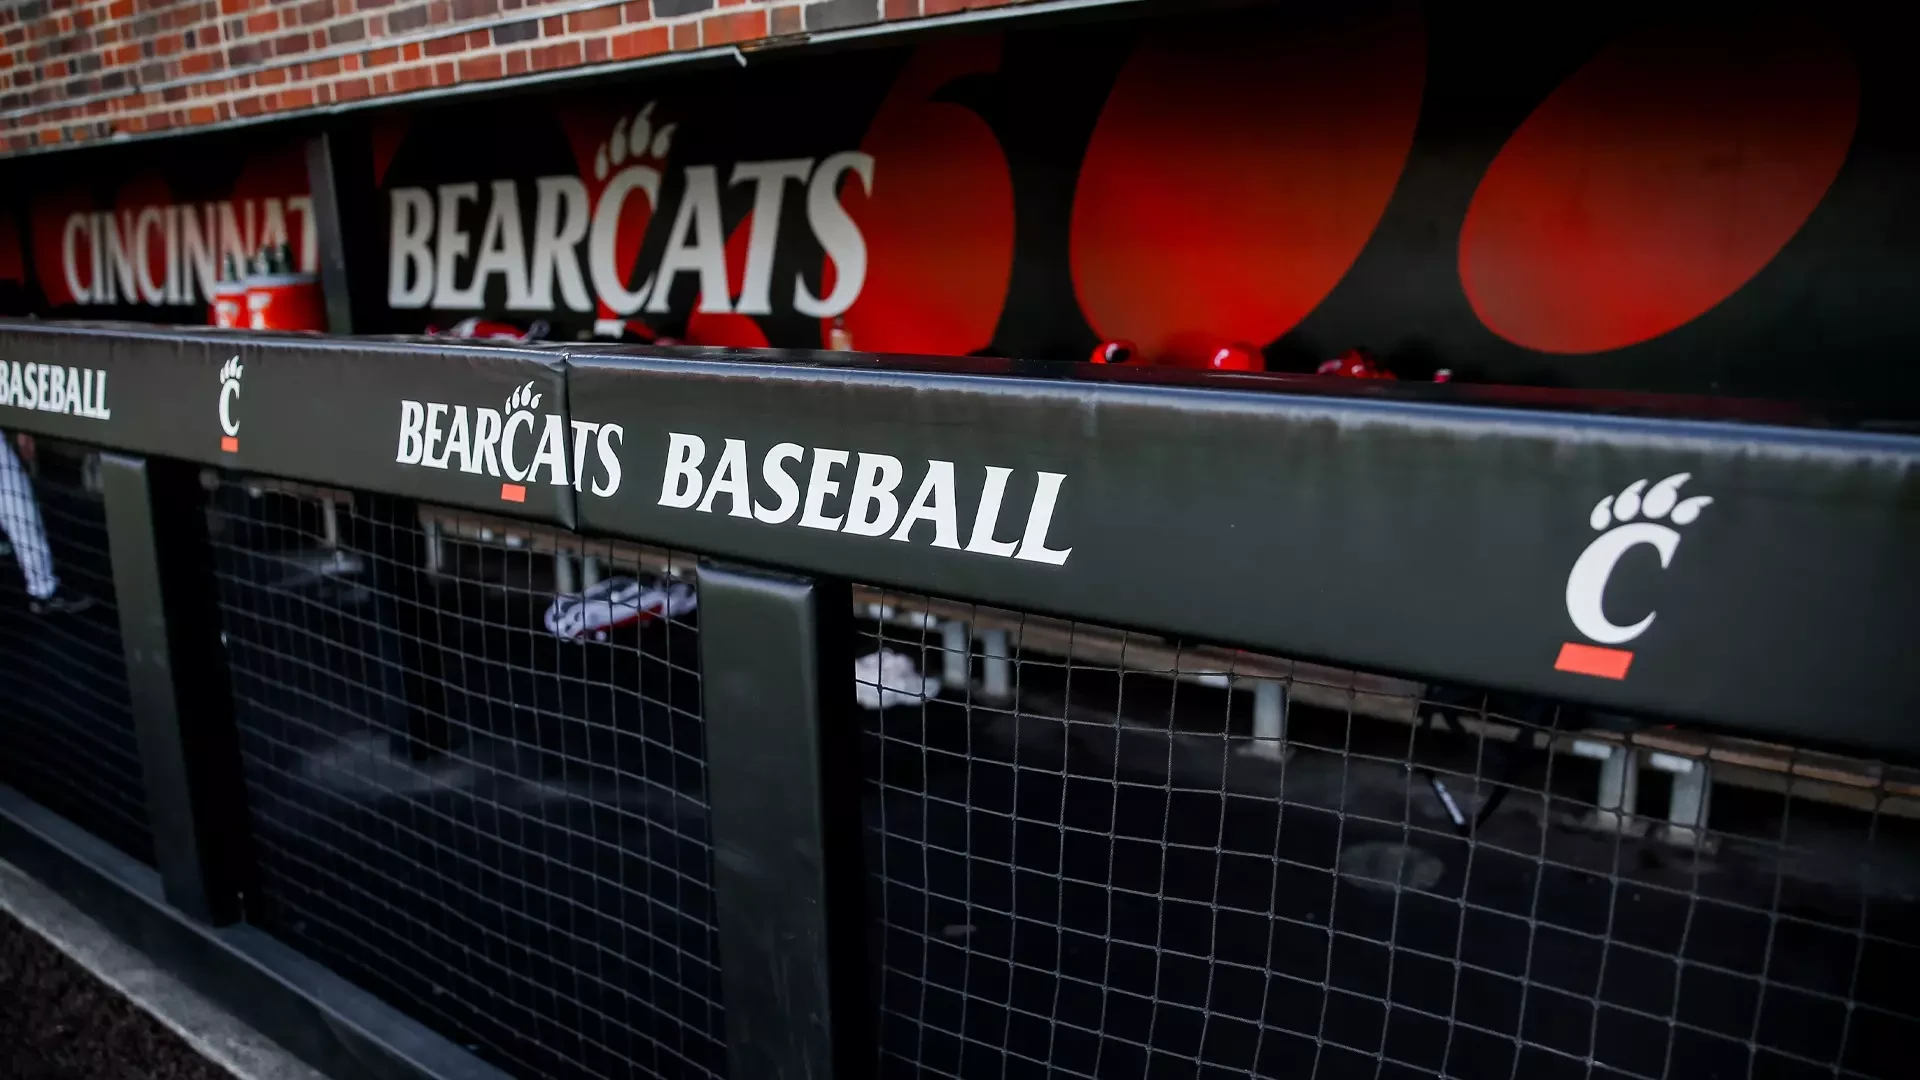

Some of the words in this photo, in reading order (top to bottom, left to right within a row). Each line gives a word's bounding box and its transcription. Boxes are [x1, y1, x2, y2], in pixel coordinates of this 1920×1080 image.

[388, 150, 876, 317] BEARCATS
[0, 360, 111, 420] BASEBALL
[396, 400, 624, 498] BEARCATS
[658, 432, 1073, 566] BASEBALL
[1565, 522, 1681, 644] C
